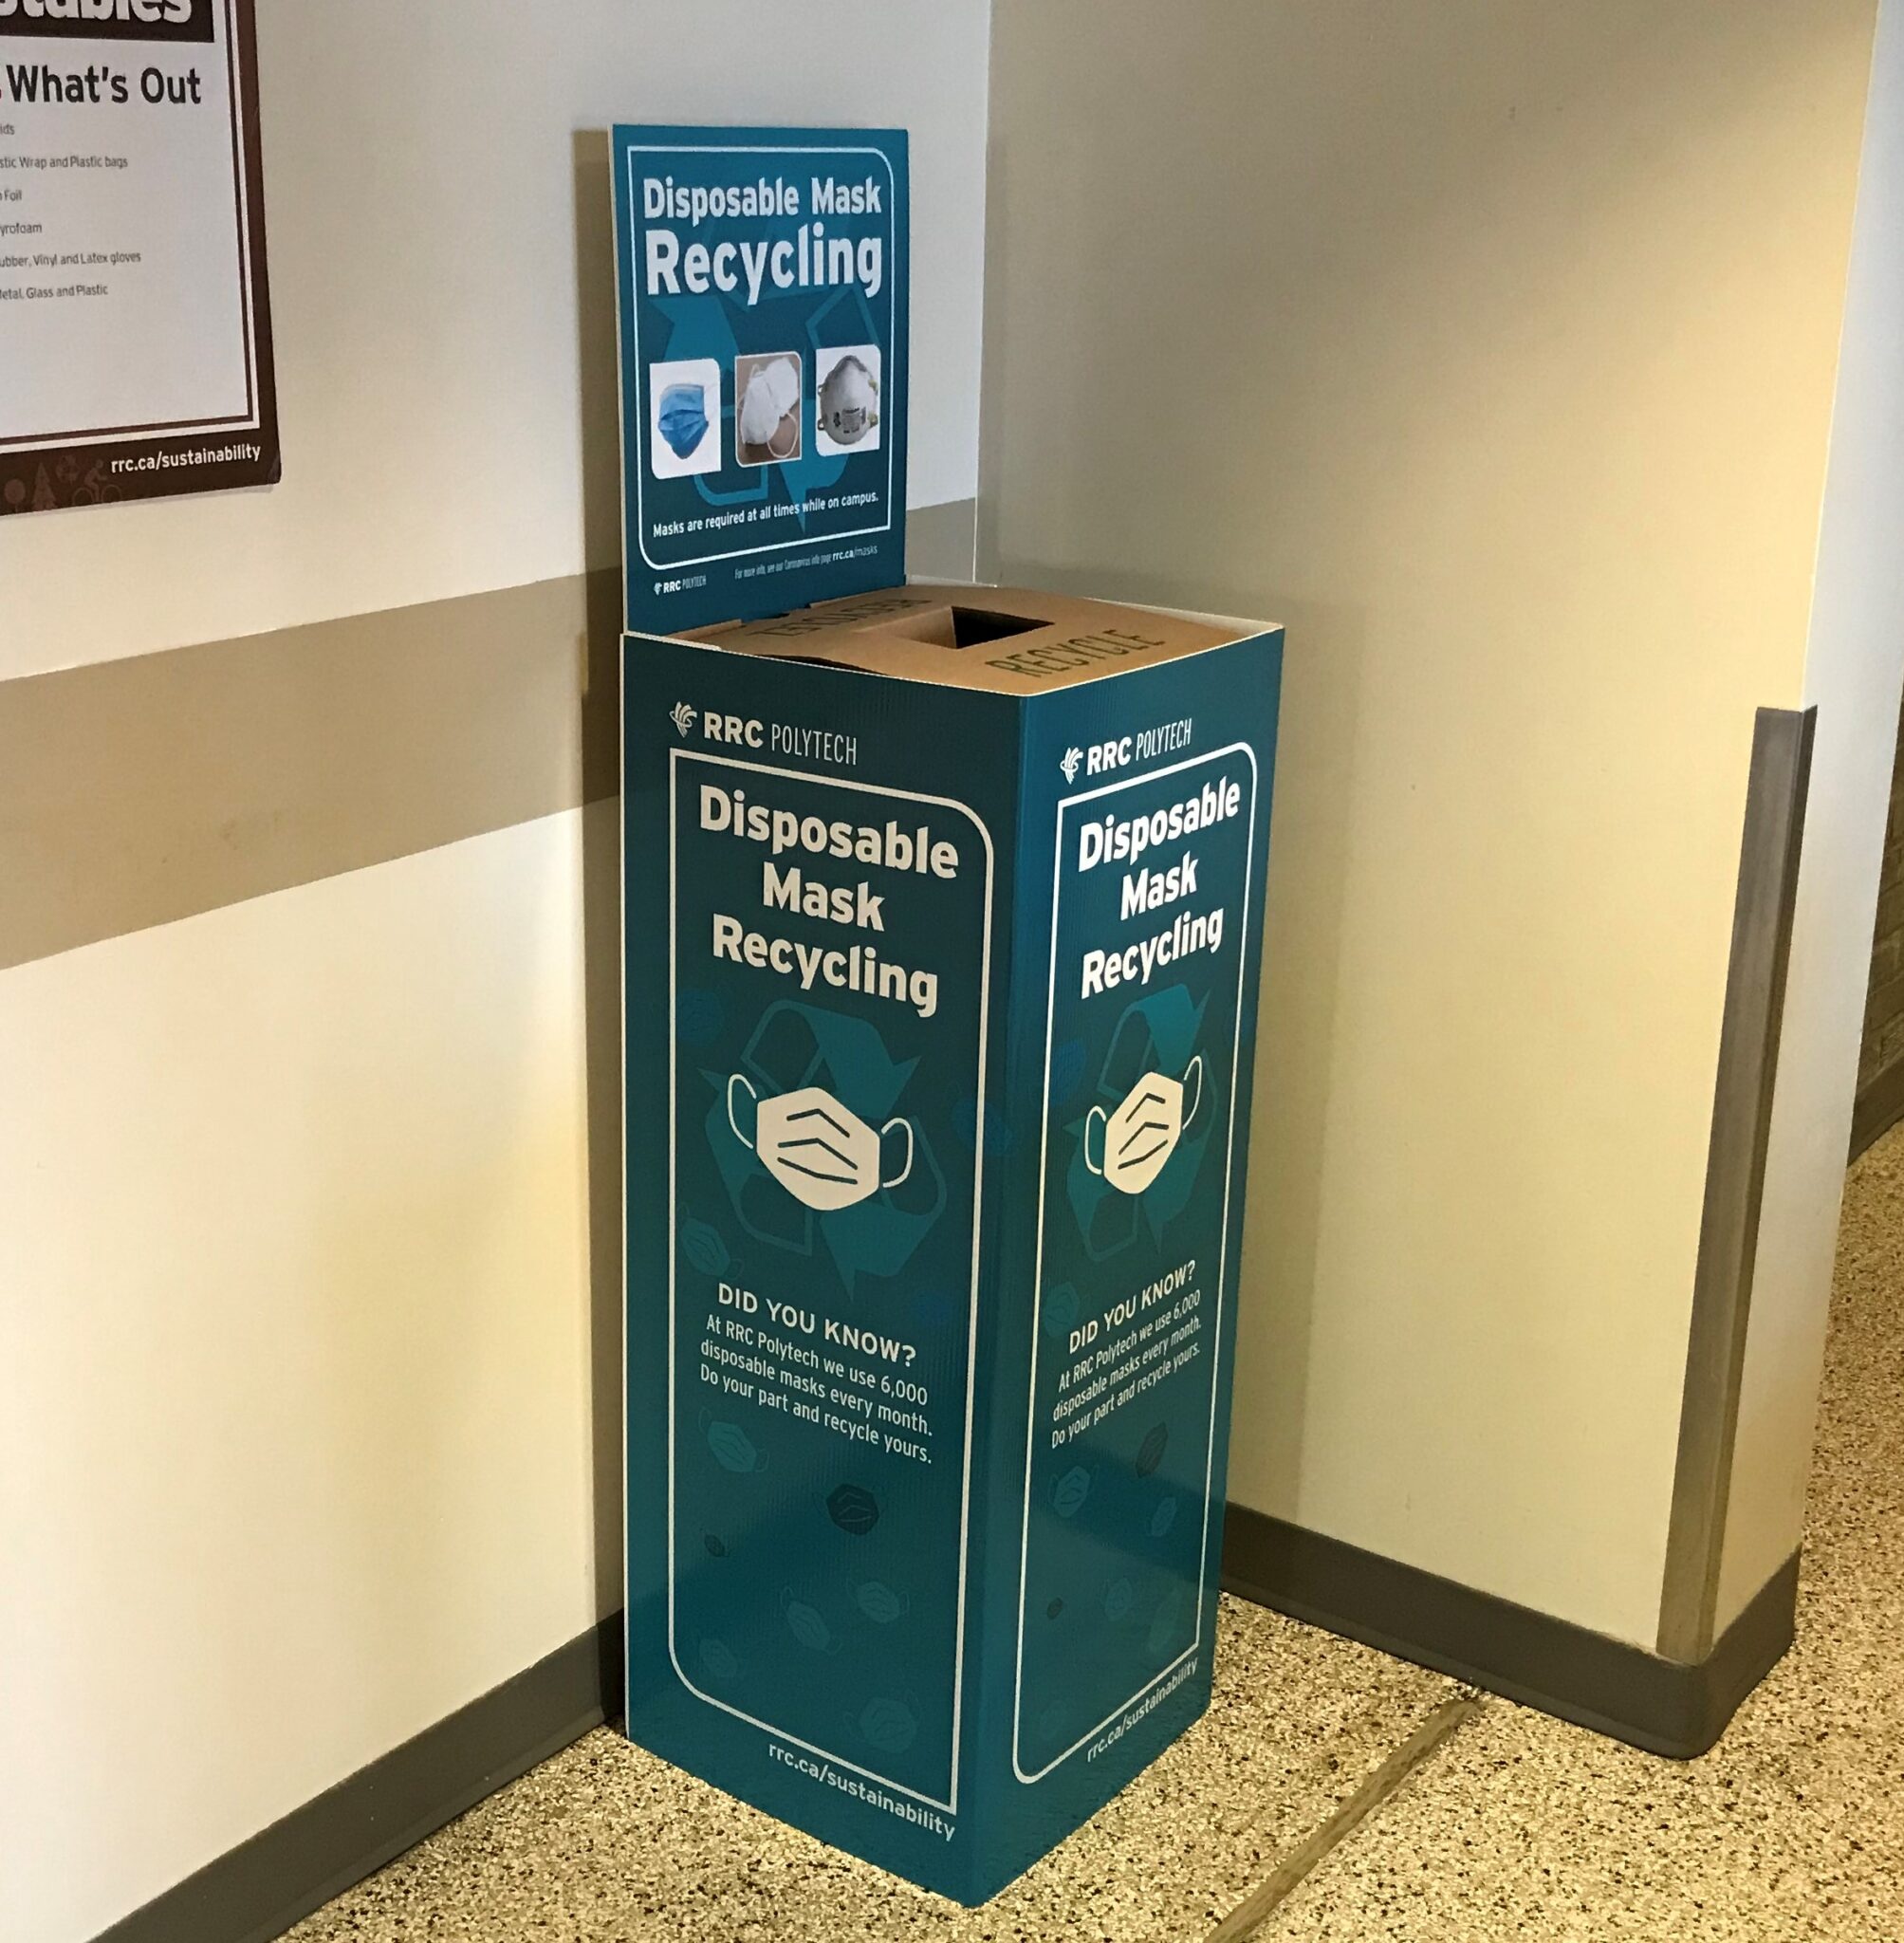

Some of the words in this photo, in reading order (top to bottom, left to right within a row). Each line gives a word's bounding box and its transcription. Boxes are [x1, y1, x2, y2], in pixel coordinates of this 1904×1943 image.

[6, 65, 129, 104] What's
[140, 67, 201, 104] Out
[19, 157, 47, 170] Wrap
[49, 156, 68, 168] and
[70, 156, 102, 168] Plastic
[104, 156, 128, 169] bags
[643, 175, 799, 228] Disposable
[811, 176, 882, 214] Mask
[26, 287, 53, 300] Glass
[56, 286, 75, 298] and
[76, 285, 108, 296] Plastic
[32, 254, 57, 268] Vinyl
[61, 252, 79, 266] and
[81, 252, 108, 265] Latex
[110, 250, 141, 266] gloves
[645, 221, 882, 305] Recycling
[111, 443, 261, 473] rrc.ca/sustainability
[653, 520, 685, 537] Masks
[687, 518, 703, 531] are
[706, 511, 745, 530] required
[747, 508, 757, 522] at
[759, 505, 770, 520] all
[773, 502, 799, 518] times
[803, 497, 825, 513] while
[827, 497, 840, 509] on
[841, 490, 878, 508] campus.
[663, 580, 681, 594] RRC
[985, 629, 1166, 678] RECYCLE
[704, 711, 764, 749] RRC
[771, 723, 858, 766] POLYTECH
[1086, 736, 1133, 776] RRC
[1136, 717, 1192, 762] POLYTECH
[699, 784, 959, 879] Disposable
[1078, 775, 1241, 873] Disposable
[763, 860, 886, 932] Mask
[1120, 850, 1199, 921] Mask
[712, 913, 938, 1019] Recycling
[1081, 907, 1224, 1000] Recycling
[718, 1283, 758, 1313] DID
[766, 1298, 816, 1334] YOU
[823, 1319, 916, 1367] KNOW?
[1059, 1370, 1070, 1393] At
[1073, 1357, 1093, 1383] RRC
[1096, 1330, 1137, 1370] Polytech
[1139, 1323, 1154, 1342] we
[1155, 1311, 1172, 1332] use
[1173, 1288, 1201, 1320] 6,000
[1069, 1320, 1099, 1354] DID
[1103, 1295, 1137, 1332] YOU
[1140, 1260, 1195, 1311] KNOW?
[700, 1340, 775, 1379] disposable
[780, 1369, 825, 1398] masks
[830, 1388, 873, 1418] every
[878, 1404, 934, 1436] month.
[706, 1314, 721, 1334] At
[726, 1321, 753, 1345] RRC
[758, 1332, 819, 1368] Polytech
[823, 1358, 844, 1378] we
[849, 1366, 877, 1389] use
[880, 1376, 928, 1406] 6,000
[1051, 1429, 1066, 1450] Do
[1068, 1413, 1092, 1442] your
[1093, 1396, 1115, 1426] part
[1117, 1381, 1135, 1407] and
[1137, 1359, 1172, 1395] recycle
[1173, 1341, 1201, 1374] yours.
[1053, 1377, 1107, 1422] disposable
[1110, 1355, 1140, 1387] masks
[1142, 1336, 1169, 1366] every
[1171, 1315, 1201, 1347] month.
[700, 1363, 719, 1385] Do
[723, 1375, 753, 1398] your
[759, 1388, 788, 1412] part
[793, 1401, 820, 1423] and
[823, 1412, 878, 1444] recycle
[883, 1433, 932, 1465] yours.
[1087, 1656, 1198, 1763] rrc.ca/sustainability
[768, 1742, 955, 1842] rrc.ca/sustainability
